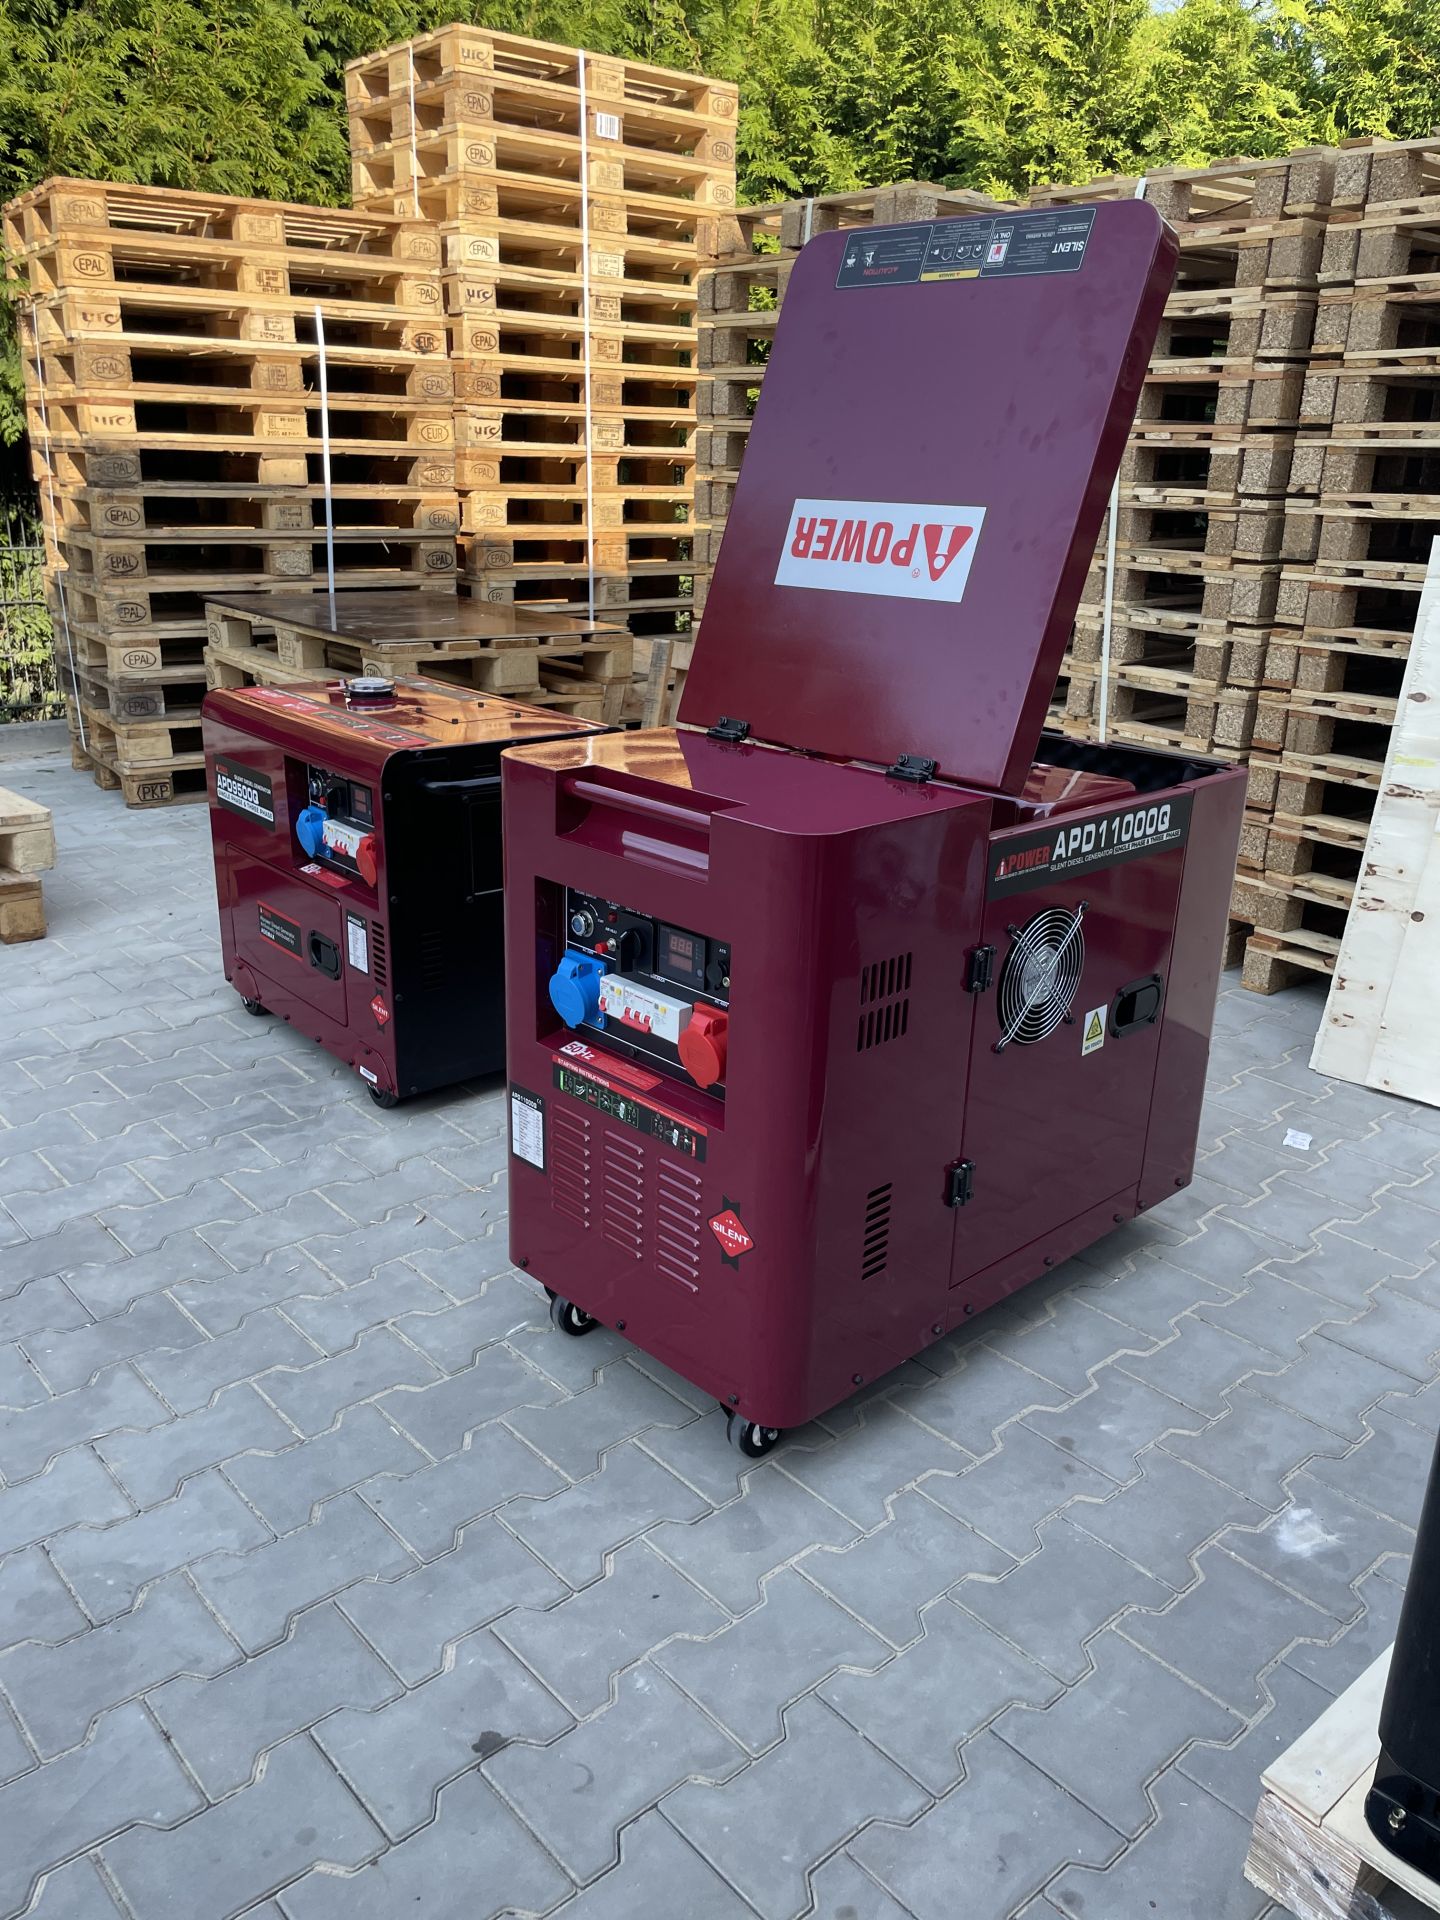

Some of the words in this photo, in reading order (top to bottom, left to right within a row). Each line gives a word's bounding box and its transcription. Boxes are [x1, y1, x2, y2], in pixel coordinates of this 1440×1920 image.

[467, 95, 486, 112] EPAL
[469, 148, 489, 162] EPAL
[715, 188, 731, 201] EPAL
[73, 203, 98, 218] EPAL
[413, 242, 433, 254] EPAL
[472, 244, 490, 257] EPAL
[1051, 240, 1085, 254] SILENT
[78, 258, 106, 273] EPAL
[863, 266, 894, 277] CAUTION
[474, 335, 494, 348] EPAL
[95, 360, 122, 376] EPAL
[426, 379, 446, 392] EPAL
[476, 380, 494, 393] EPAL
[426, 428, 443, 440] EUR
[474, 466, 492, 479] EPAL
[432, 513, 453, 527] EPAL
[110, 556, 134, 569] EPAL
[431, 554, 449, 567] EPAL
[128, 653, 153, 666] EPAL
[128, 700, 151, 714] EPAL
[142, 784, 169, 801] PKP
[1051, 803, 1171, 861] APD11000Q
[1050, 860, 1067, 872] SILENT
[1067, 856, 1084, 868] DIESEL
[1084, 848, 1113, 863] GENERATOR
[564, 1042, 596, 1061] 50Hz
[557, 1057, 579, 1074] STARTING
[578, 1068, 610, 1088] INSTRUCTIONS
[712, 1221, 750, 1246] SILENT
